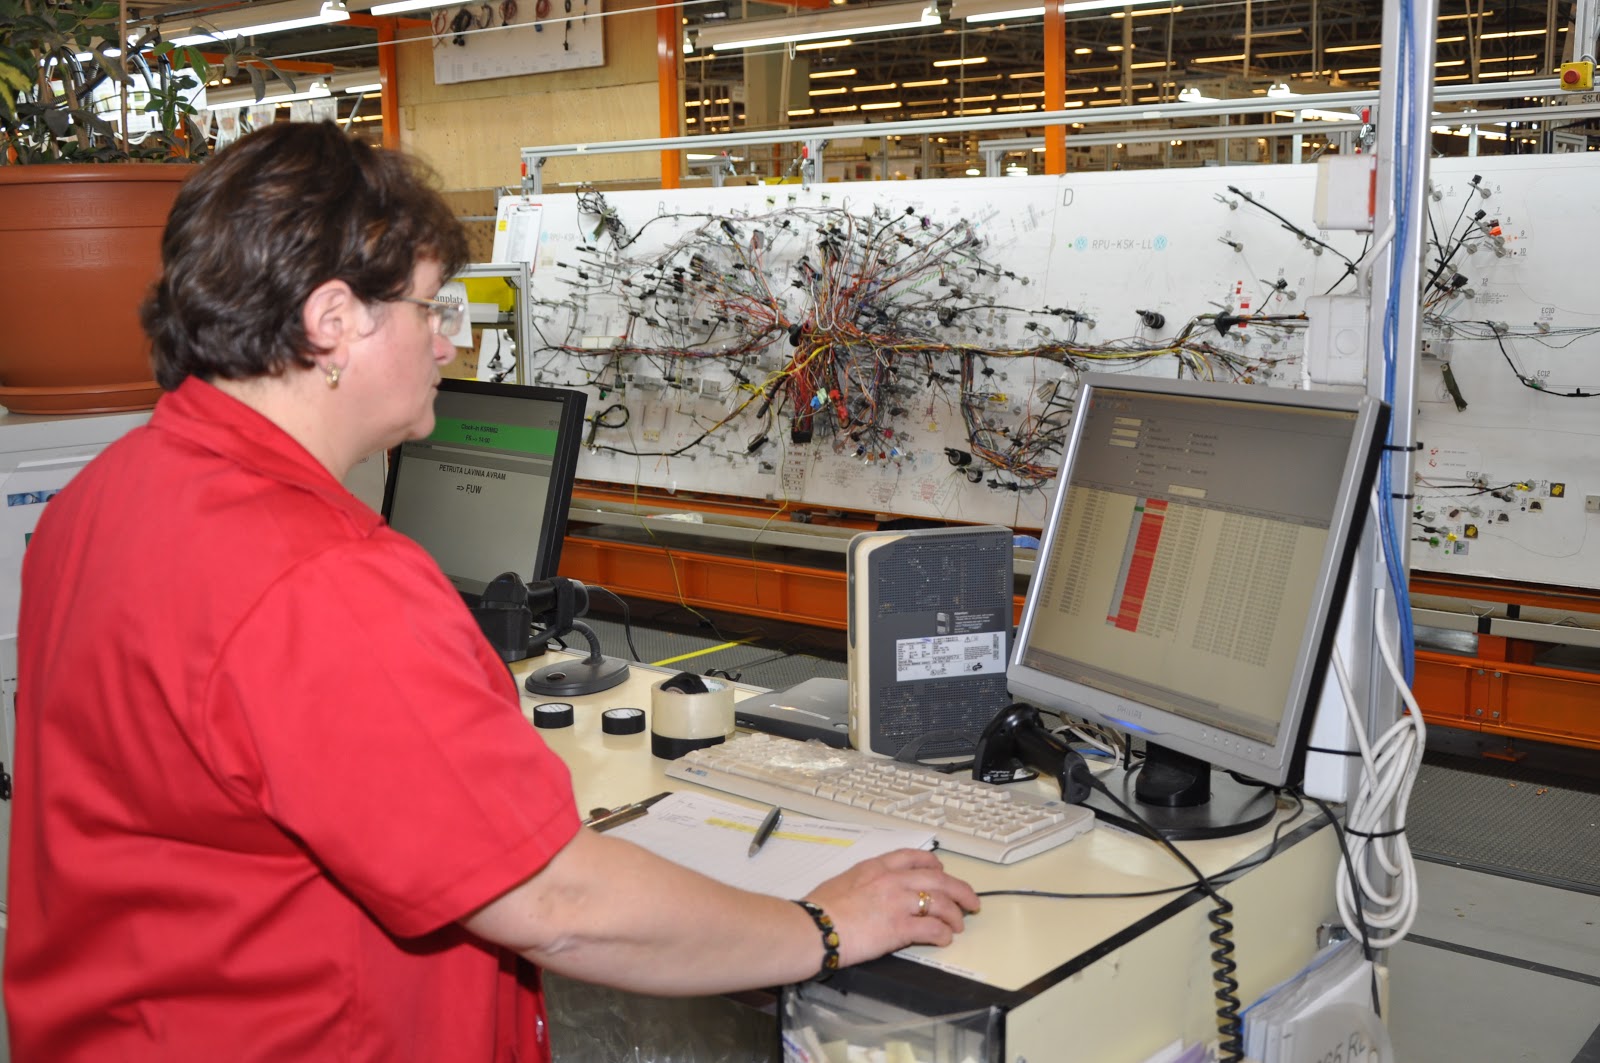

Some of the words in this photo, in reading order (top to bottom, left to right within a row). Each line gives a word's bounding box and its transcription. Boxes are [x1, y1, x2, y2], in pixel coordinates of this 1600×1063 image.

[1063, 188, 1074, 206] D
[434, 294, 463, 304] anplatz
[439, 464, 463, 474] PETRUTA
[464, 468, 485, 477] LAVINIA
[486, 471, 507, 480] AVRAM
